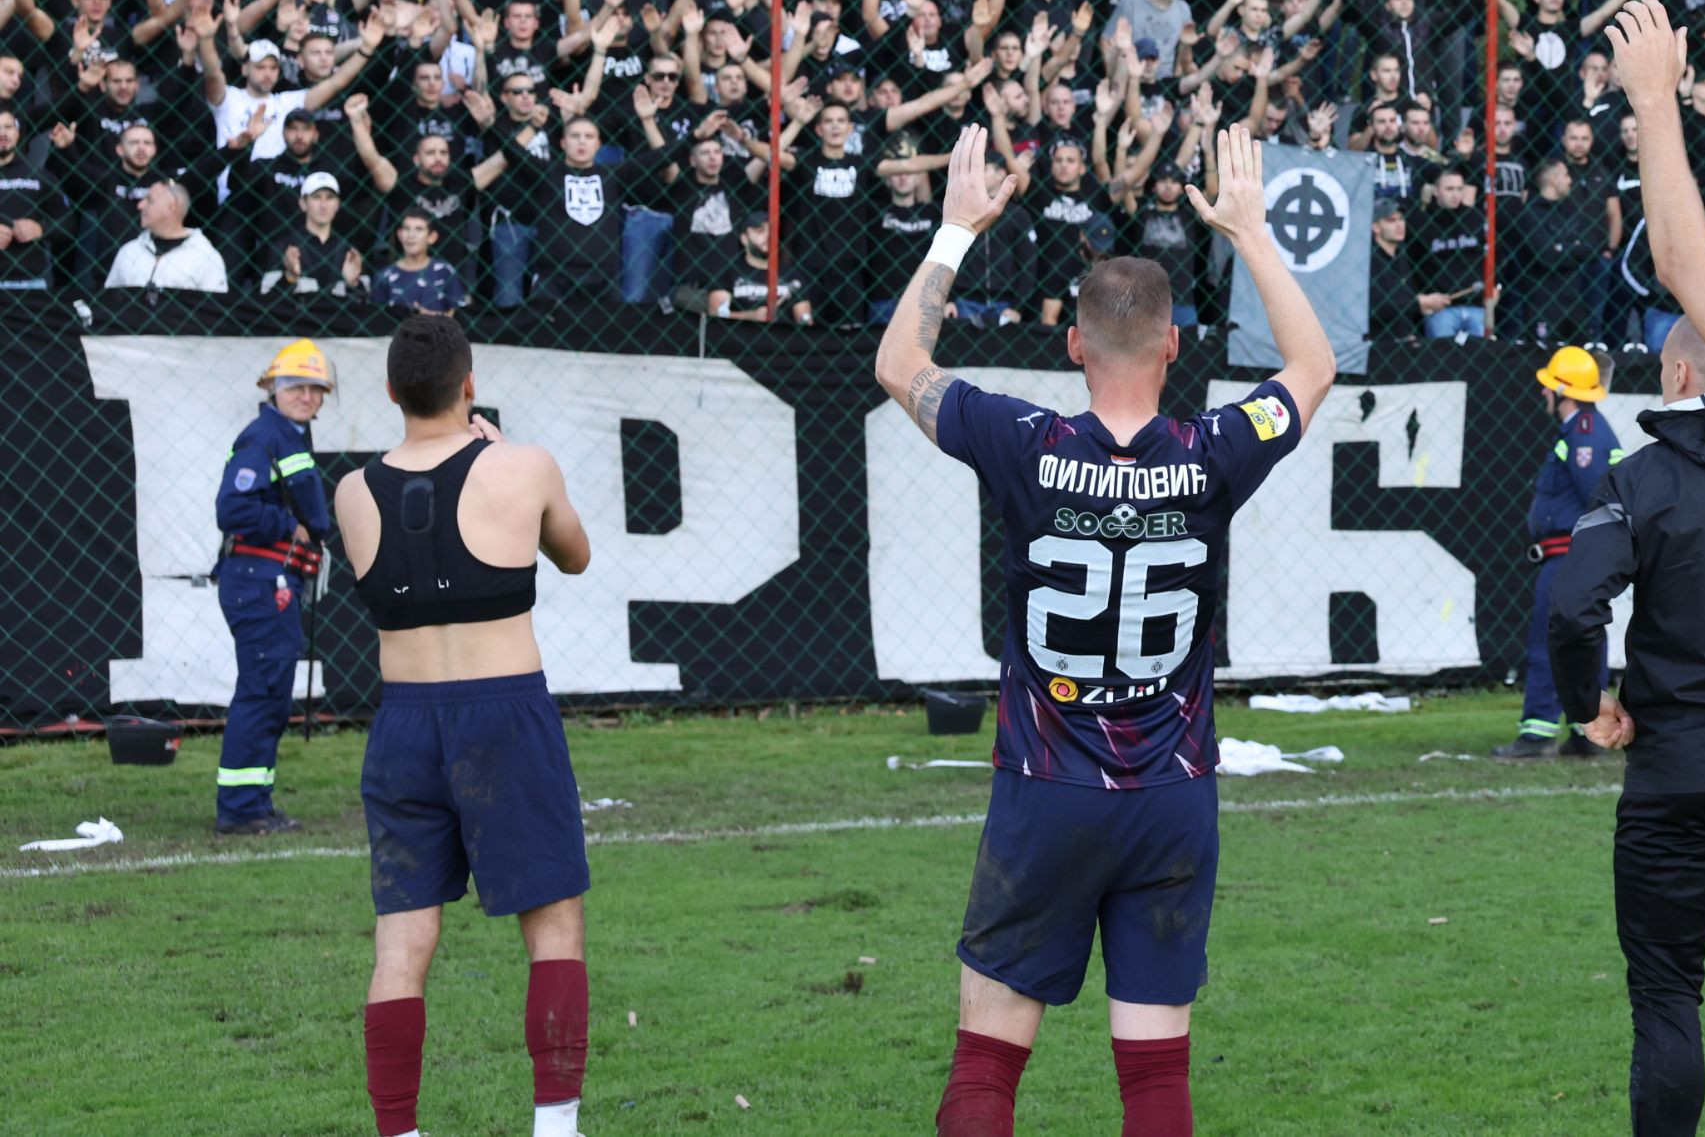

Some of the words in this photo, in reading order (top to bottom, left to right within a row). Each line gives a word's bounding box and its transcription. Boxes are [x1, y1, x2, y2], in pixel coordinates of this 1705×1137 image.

[1038, 454, 1207, 499] ФИЛИПОВИЋ
[1054, 507, 1188, 539] SOCCER
[1026, 534, 1208, 680] 26
